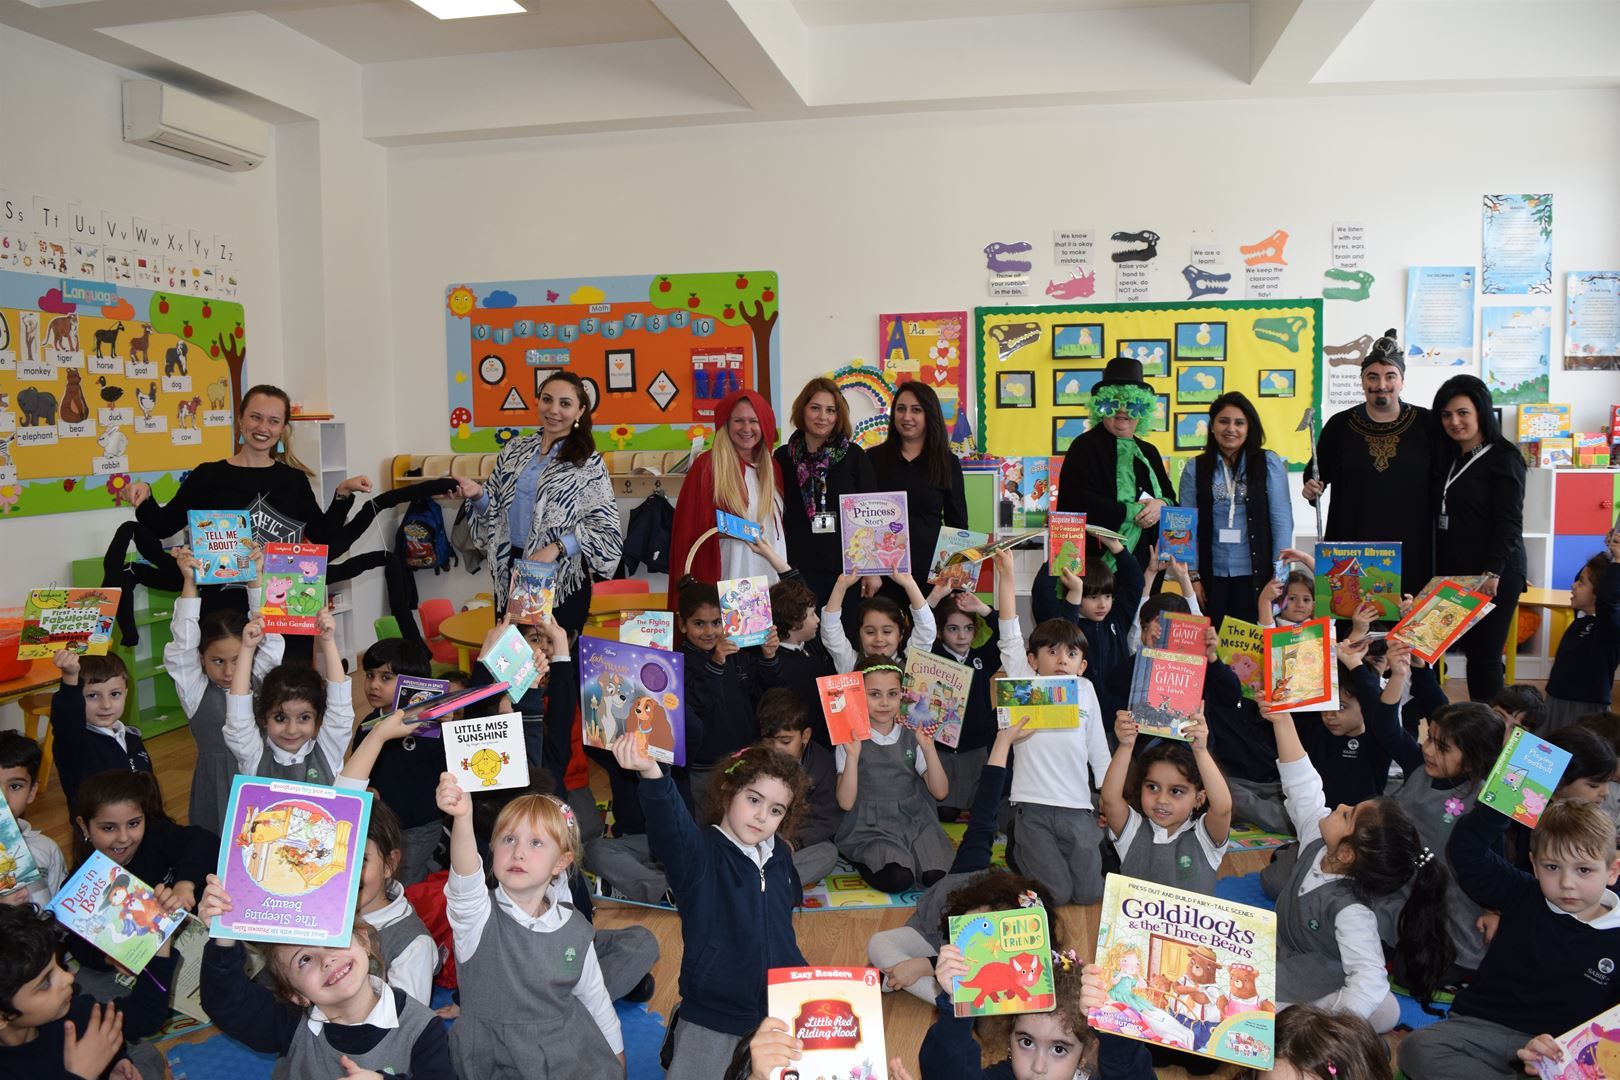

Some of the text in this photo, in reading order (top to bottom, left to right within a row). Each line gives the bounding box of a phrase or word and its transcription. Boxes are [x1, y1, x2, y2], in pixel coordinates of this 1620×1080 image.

[478, 328, 486, 339] 0
[520, 323, 528, 336] 2
[542, 325, 549, 337] 3
[564, 328, 572, 340] 4
[587, 321, 594, 332] 5
[608, 324, 614, 336] 6
[630, 315, 638, 326] 7
[652, 317, 660, 330] 8
[676, 314, 683, 326] 9
[695, 321, 710, 334] 10
[886, 315, 909, 360] A
[57, 354, 72, 363] tiger
[527, 350, 570, 364] Shapes
[24, 366, 50, 377] monkey
[134, 368, 148, 376] goat
[172, 380, 182, 390] dog
[108, 413, 122, 421] duck
[210, 414, 224, 422] sheep
[70, 425, 84, 433] bear
[144, 421, 156, 429] hen
[22, 432, 52, 442] elephant
[102, 461, 120, 470] rabbit
[854, 507, 896, 518] Princess
[205, 530, 238, 540] TELL ME
[208, 541, 238, 551] ABOUT?
[1333, 548, 1396, 557] Nursery Rhymes
[42, 614, 96, 625] Fabulous
[648, 618, 670, 626] Flying
[51, 622, 89, 632] Facts
[1228, 626, 1246, 636] The
[1173, 628, 1198, 640] GIANT
[1221, 637, 1250, 650] Messy
[1168, 662, 1195, 676] Smartest
[912, 662, 963, 691] Cinderella
[1156, 670, 1191, 688] GIANT
[825, 675, 860, 690] English
[1168, 686, 1184, 694] Town
[454, 720, 508, 734] LITTLE MISS
[458, 730, 508, 743] SUNSHINE
[1524, 755, 1552, 774] Football
[60, 878, 90, 913] Puss
[86, 868, 99, 882] in
[80, 878, 107, 914] Boots
[262, 898, 303, 911] Beauty
[1128, 883, 1147, 892] PRESS
[1162, 890, 1174, 899] AND
[1175, 894, 1192, 903] BUILD
[1192, 898, 1230, 912] FAIRY-TALE
[1230, 908, 1254, 918] SCENES
[244, 908, 318, 927] The Sleeping
[1122, 898, 1255, 945] Goldilocks
[1129, 920, 1252, 959] & the Three Bears
[790, 969, 852, 980] Easy Readers
[867, 976, 873, 986] 1
[805, 1016, 854, 1028] Little Red
[797, 1026, 858, 1040] Riding Hood
